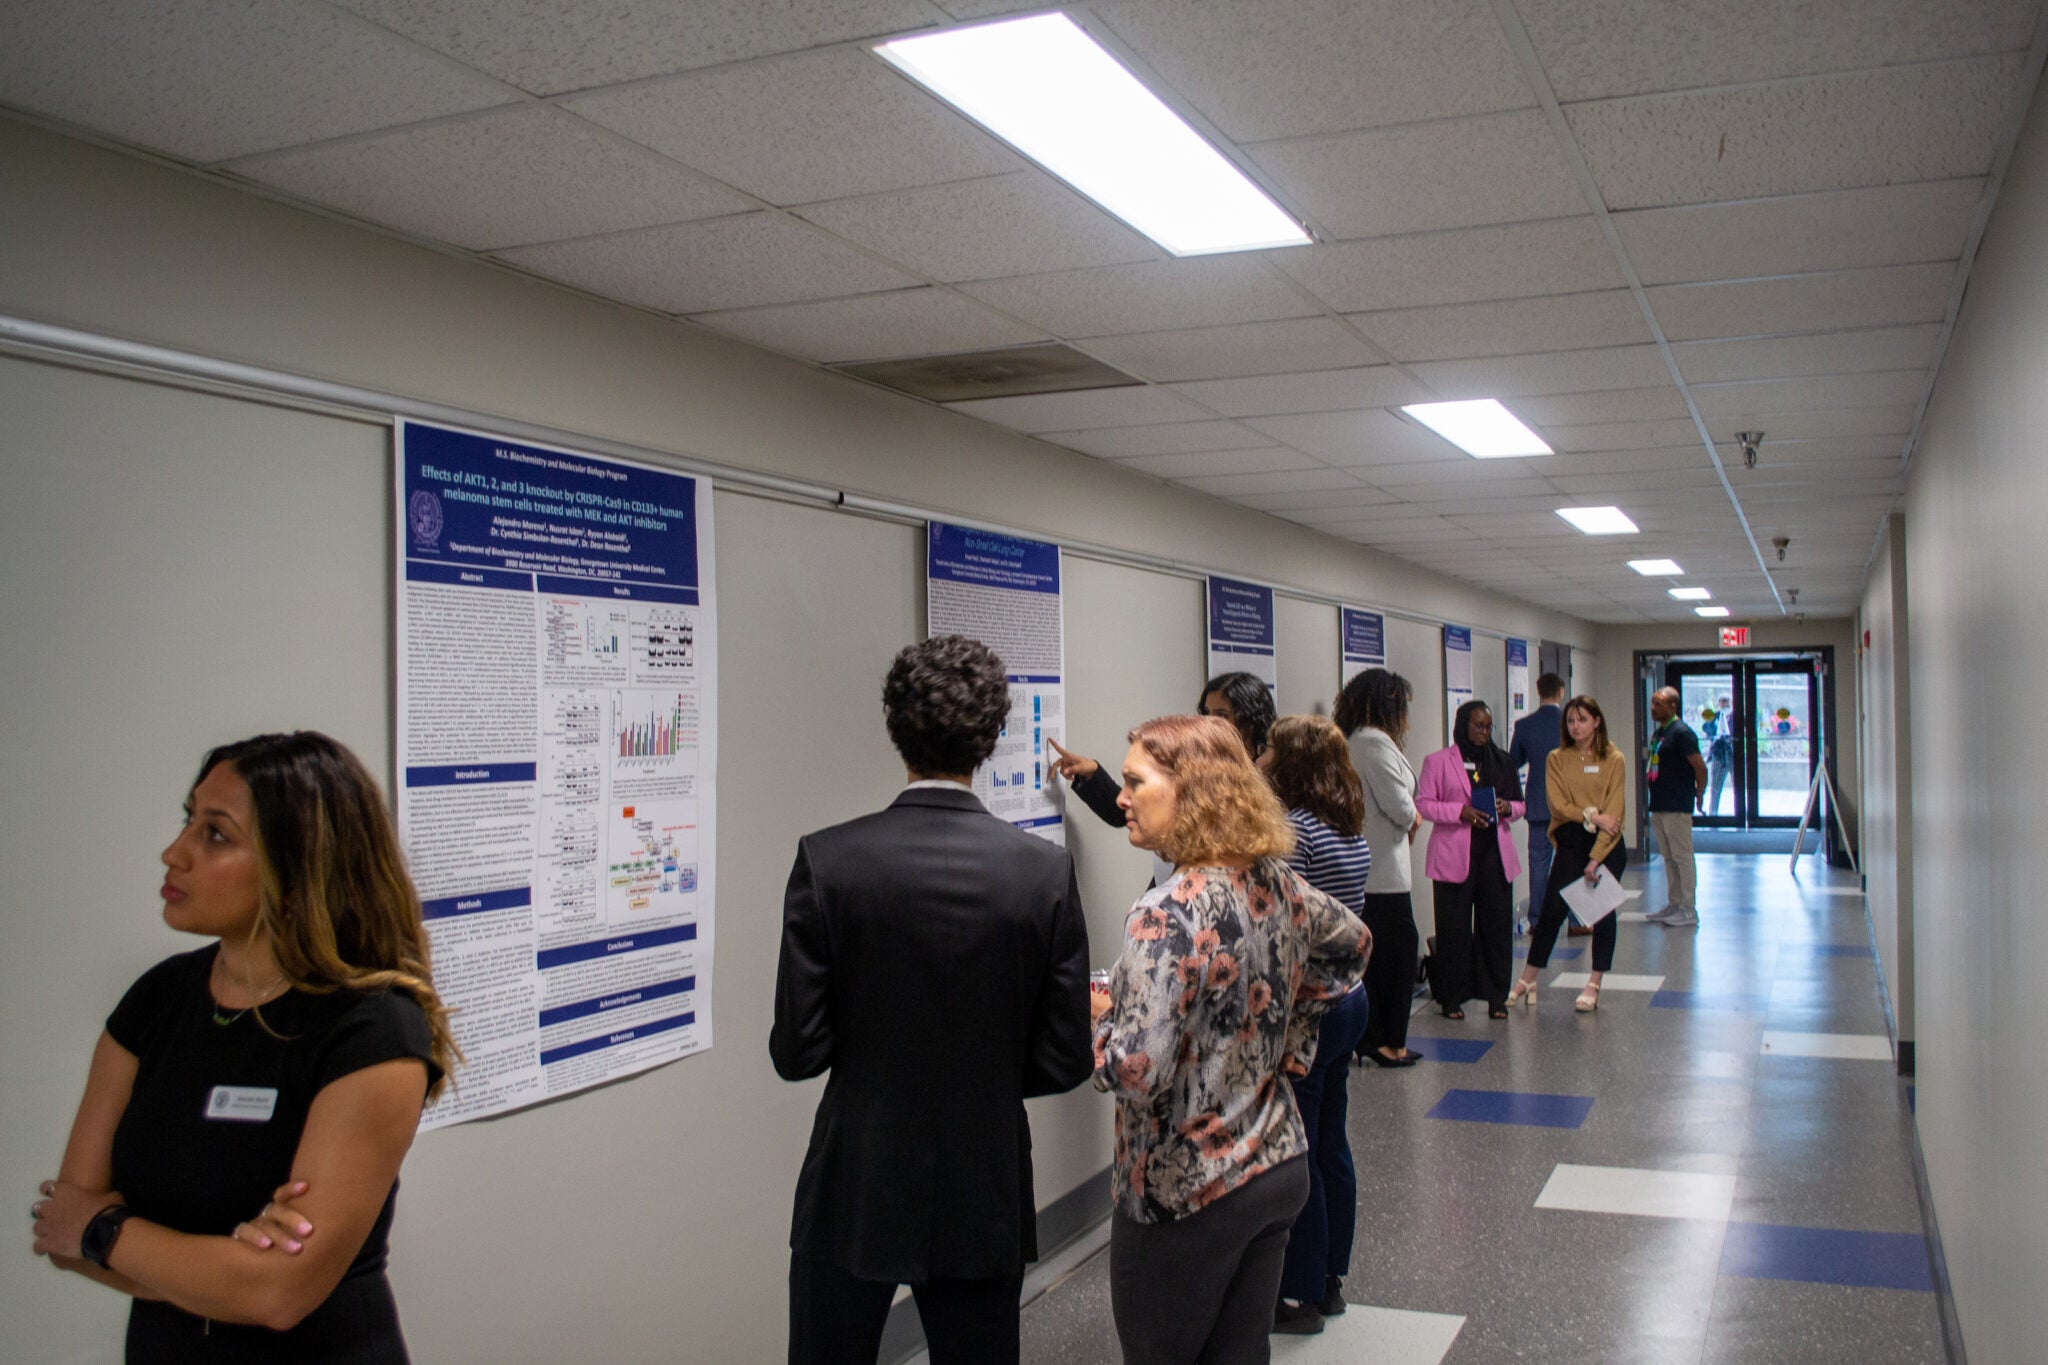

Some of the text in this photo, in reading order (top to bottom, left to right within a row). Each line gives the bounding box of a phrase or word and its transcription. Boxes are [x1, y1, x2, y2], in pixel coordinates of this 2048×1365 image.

[496, 448, 628, 482] M.S. Biochemistry and Molecular Biology Program
[422, 464, 684, 519] Effects of AKT1, 2, and 3 knockout by CRISPR-Cas9 in CD133+ human
[444, 488, 668, 531] melanoma stem cells treated with MEK and AKT inhibitors
[491, 527, 500, 537] Dr.
[582, 540, 590, 548] Dr.
[492, 546, 524, 560] Biochemistry
[525, 551, 534, 560] and
[536, 552, 560, 563] Molecular
[610, 560, 633, 573] University
[633, 562, 651, 574] Medical
[461, 572, 484, 582] Abstract
[614, 586, 630, 596] Results
[1724, 628, 1748, 646] EXIT
[456, 770, 490, 780] Introduction
[458, 900, 482, 910] Methods
[607, 940, 634, 952] Conclusions
[610, 1030, 635, 1044] References
